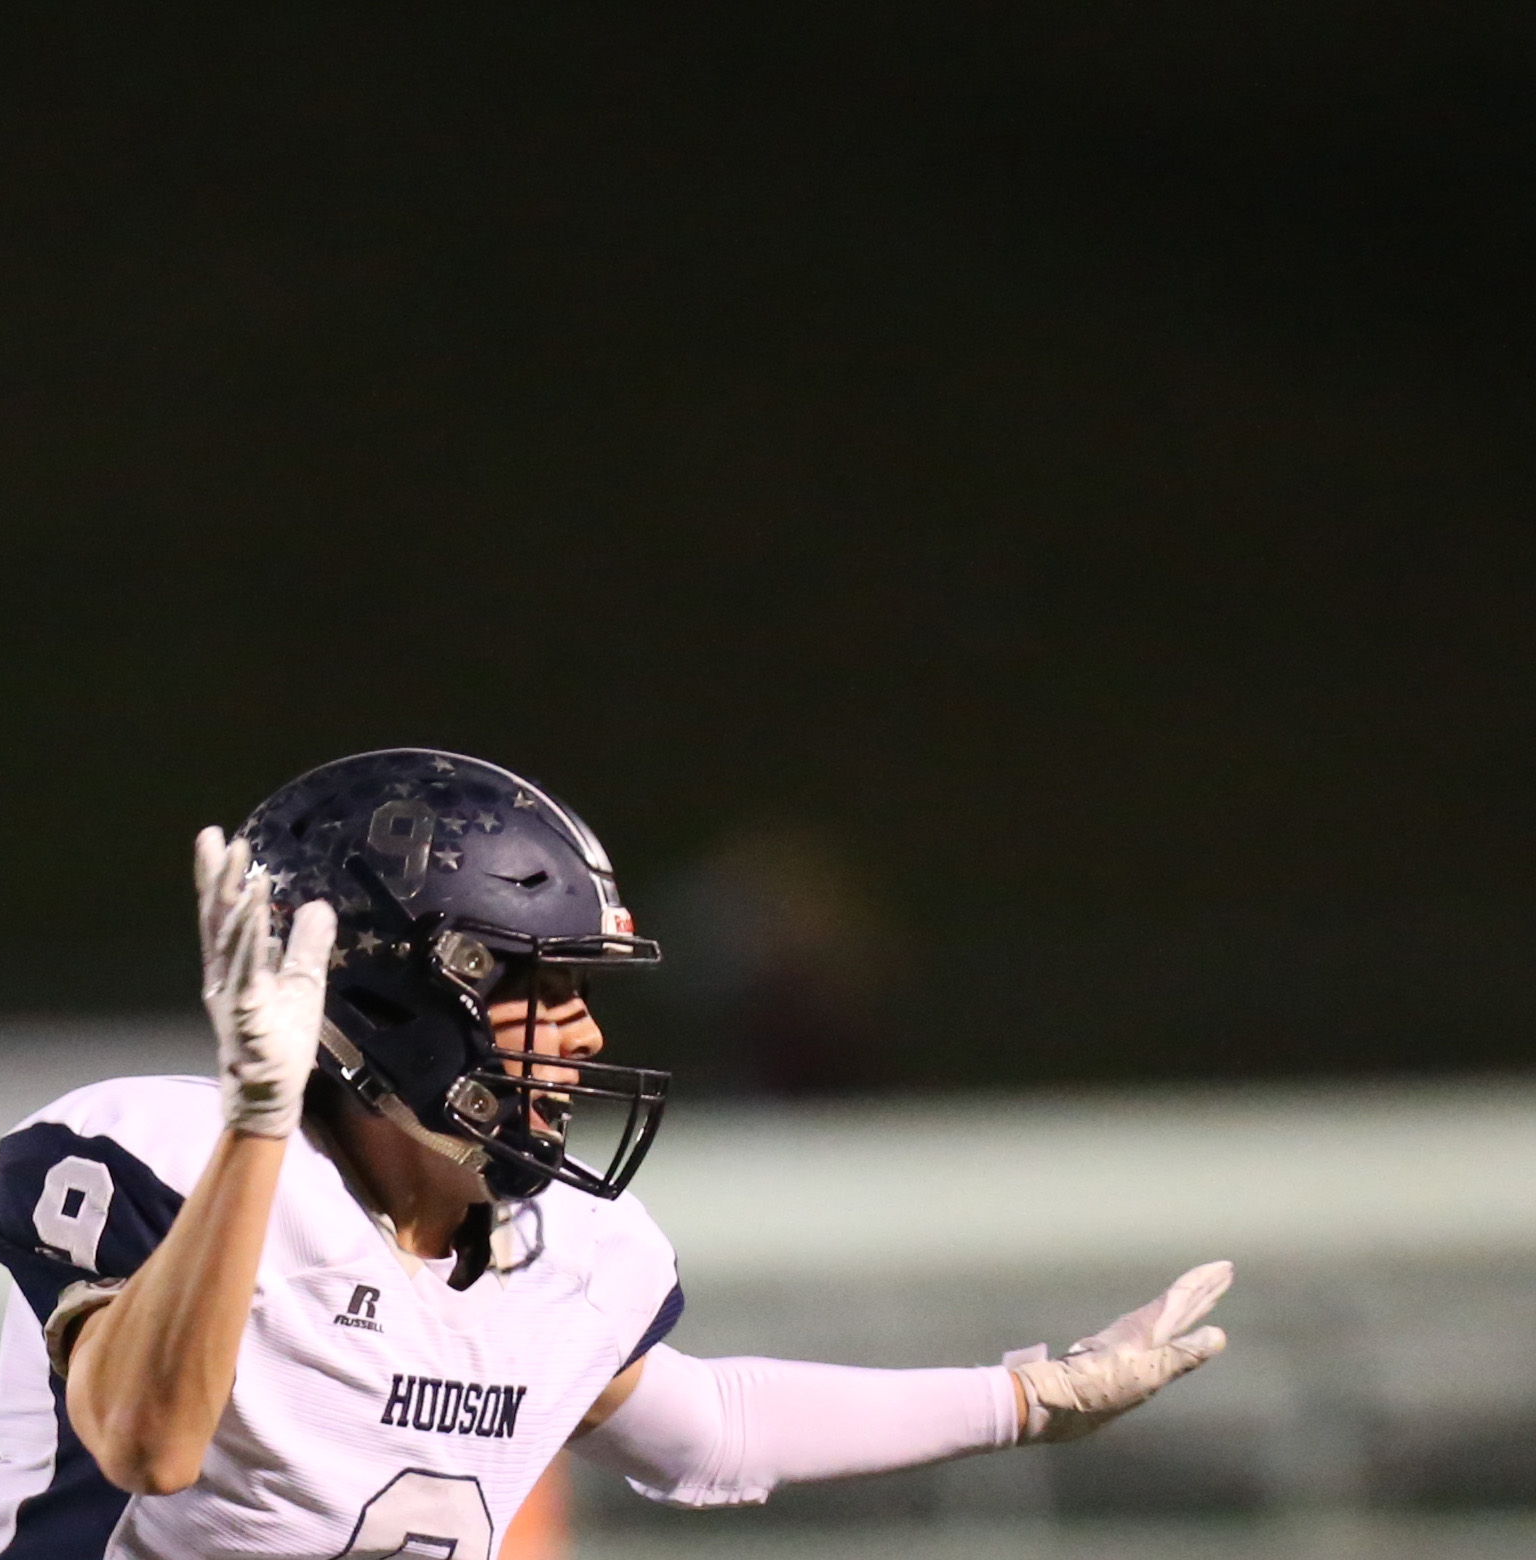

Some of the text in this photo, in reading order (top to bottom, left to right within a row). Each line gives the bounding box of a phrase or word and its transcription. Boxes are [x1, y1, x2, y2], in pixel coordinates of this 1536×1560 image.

[367, 800, 437, 899] 9
[333, 1314, 384, 1333] RUSSELL
[347, 1284, 381, 1319] R
[380, 1373, 527, 1438] HUDSON
